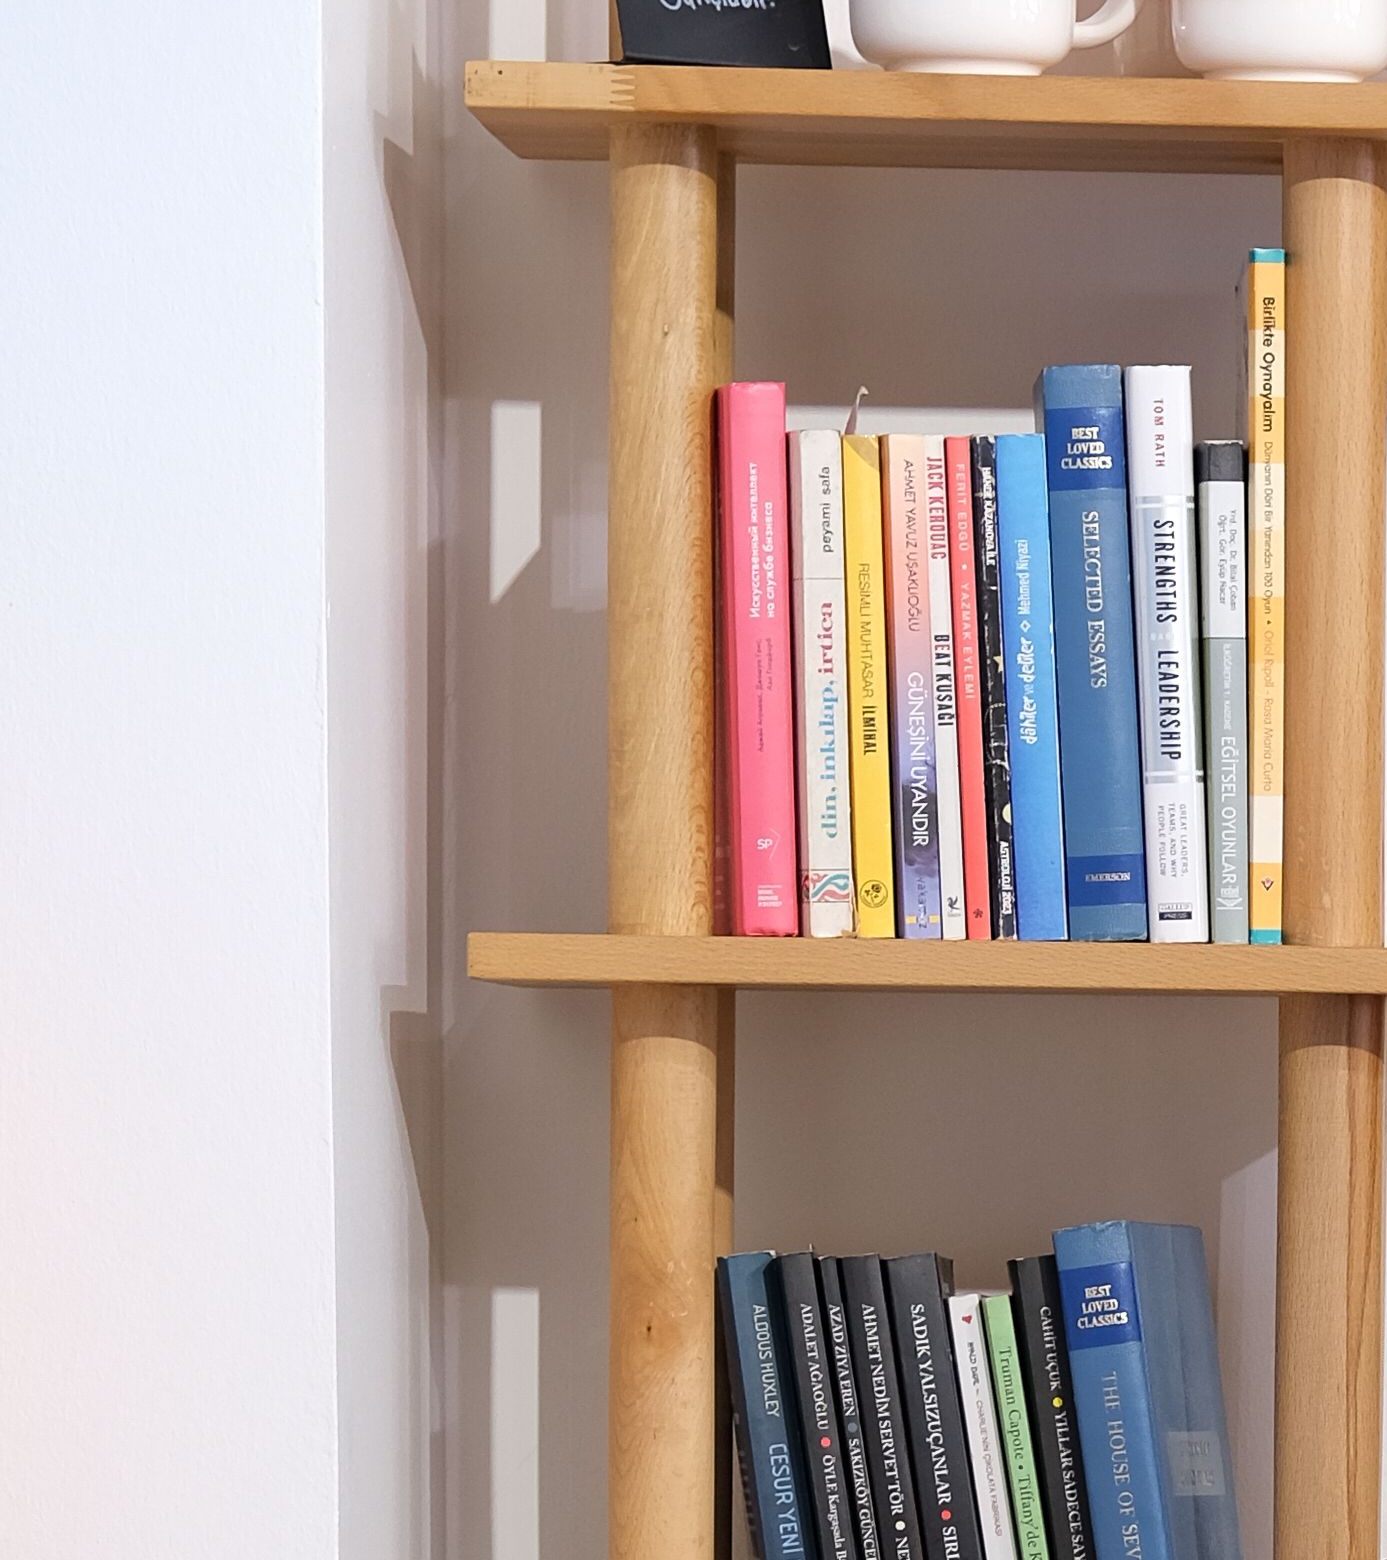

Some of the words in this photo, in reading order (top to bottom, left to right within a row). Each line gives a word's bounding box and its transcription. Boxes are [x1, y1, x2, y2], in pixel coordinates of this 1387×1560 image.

[1072, 426, 1099, 439] BEST
[1153, 398, 1164, 426] TOM
[927, 457, 943, 491] JACK
[1061, 456, 1113, 470] CLASSICS
[1067, 441, 1105, 455] LOVED
[1155, 433, 1166, 467] RATH
[818, 466, 831, 495] safa
[904, 459, 916, 503] AHMET
[822, 503, 834, 553] peyami
[905, 507, 917, 546] YAVUZ
[929, 496, 947, 560] KEROUAC
[1082, 511, 1104, 614] SELECTED
[1154, 519, 1177, 623] STRENGTHS
[907, 550, 920, 632] UŞAKLIOĞLU
[1087, 619, 1108, 688] ESSAYS
[907, 671, 927, 761] GÜNEŞİNİ
[1157, 650, 1182, 761] LEADERSHIP
[1221, 737, 1239, 803] EĞİTSEL
[910, 768, 929, 847] UYANDIR
[1221, 809, 1237, 884] OYUNLAR
[1081, 1298, 1119, 1314] LOVED
[1084, 1284, 1112, 1298] BEST
[753, 1304, 773, 1361] ALDOUS
[910, 1303, 931, 1359] SADIK
[1077, 1311, 1128, 1329] CLASSICS
[760, 1362, 781, 1419] HUXLEY
[1000, 1346, 1016, 1406] Truman
[1101, 1370, 1120, 1409] THE
[918, 1359, 952, 1505] YALSIZUÇANLAR
[1005, 1408, 1024, 1460] Capote
[1107, 1420, 1131, 1486] HOUSE
[768, 1443, 794, 1505] CESUR
[778, 1508, 800, 1555] YENİ
[1018, 1474, 1040, 1546] Tiffany'de
[1118, 1491, 1135, 1517] OF
